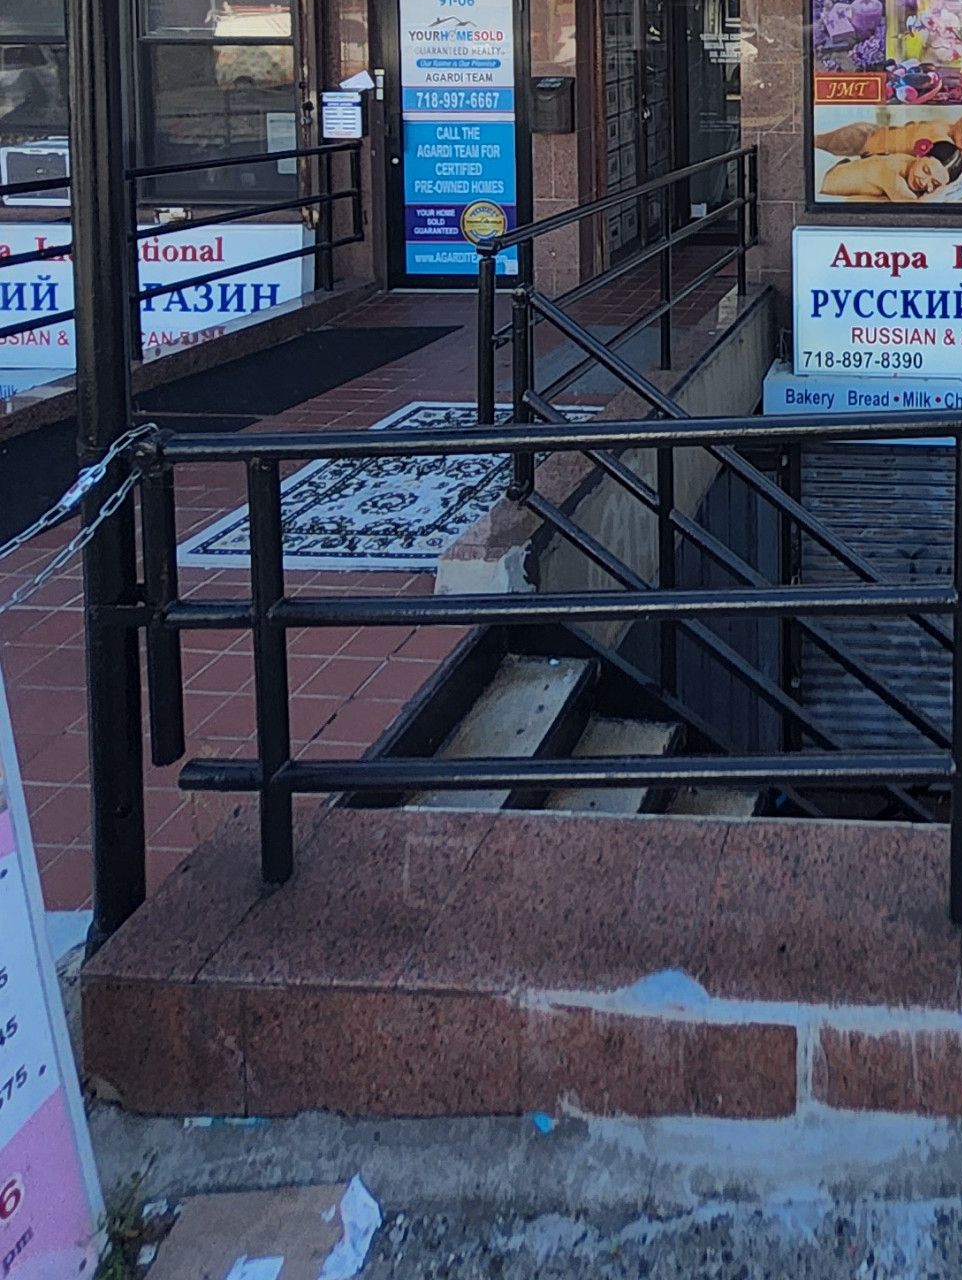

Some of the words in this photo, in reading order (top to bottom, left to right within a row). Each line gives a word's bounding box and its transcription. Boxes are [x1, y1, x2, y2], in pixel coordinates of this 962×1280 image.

[426, 73, 463, 82] AGARDI
[467, 73, 493, 82] TEAM
[827, 80, 868, 98] JMT
[417, 92, 499, 108] 718-997-6667
[437, 127, 460, 140] CALL
[463, 127, 480, 140] THE
[417, 145, 452, 158] AGARDI
[454, 145, 479, 158] TEAM
[481, 145, 500, 158] FOR
[436, 163, 482, 175] CERTIFIED
[415, 181, 469, 193] PRE-OWNED
[472, 181, 504, 193] HOMES
[830, 243, 928, 277] Anapa
[851, 328, 938, 346] RUSSIAN
[943, 328, 956, 346] &
[802, 352, 923, 370] 718-897-8390
[785, 389, 835, 409] Bakery
[848, 390, 889, 407] Bread
[903, 391, 930, 408] Milk
